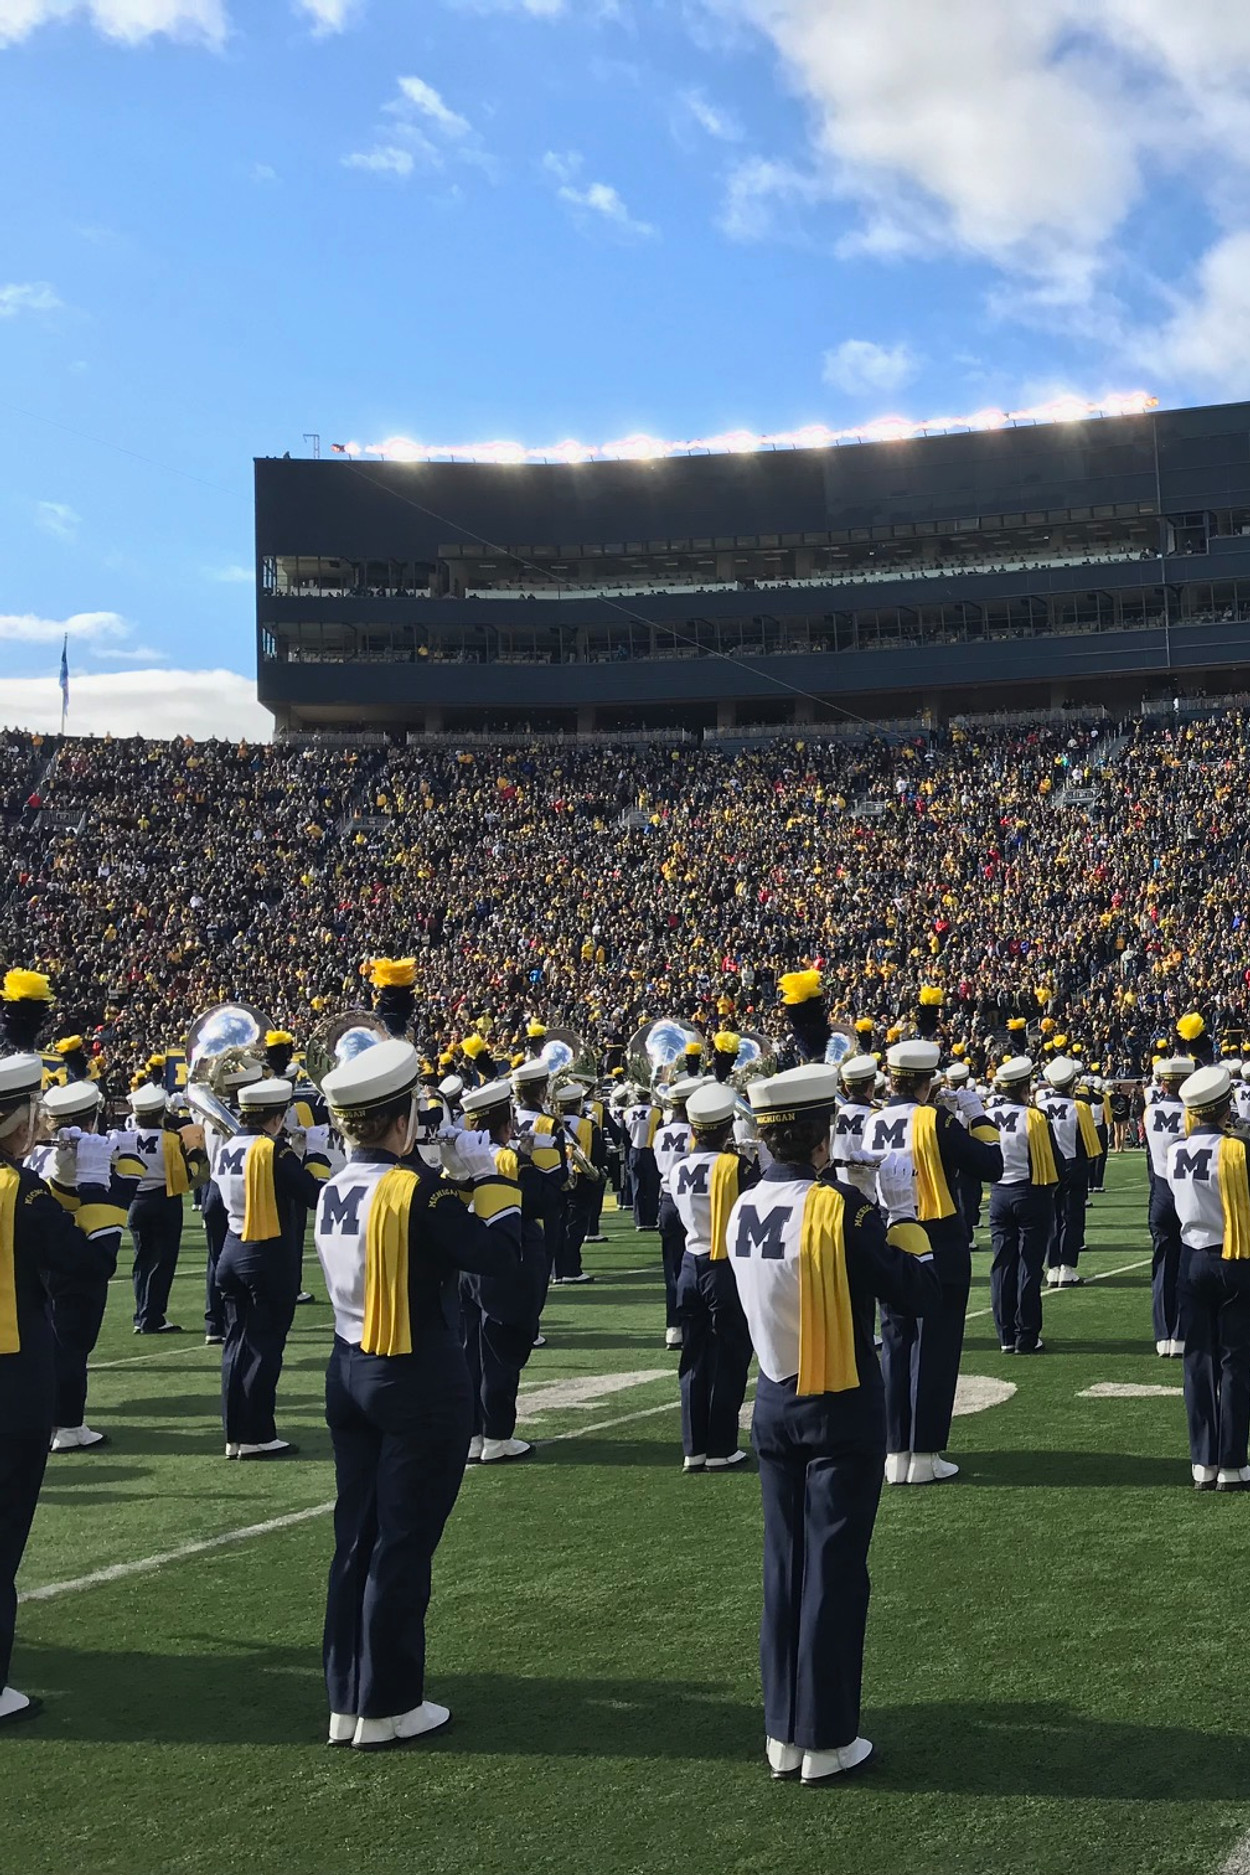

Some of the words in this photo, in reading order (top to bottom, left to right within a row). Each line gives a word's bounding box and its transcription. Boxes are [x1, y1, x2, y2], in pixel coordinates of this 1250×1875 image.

[632, 1110, 647, 1120] M
[994, 1111, 1020, 1132] M
[1046, 1104, 1068, 1120] M
[1153, 1110, 1181, 1133] M
[836, 1114, 865, 1135] M
[872, 1118, 908, 1150] M
[137, 1135, 159, 1154] M
[661, 1132, 688, 1152] M
[217, 1148, 246, 1175] M
[1174, 1148, 1213, 1180] M
[677, 1164, 710, 1195] M
[320, 1185, 370, 1235] M
[735, 1205, 793, 1259] M
